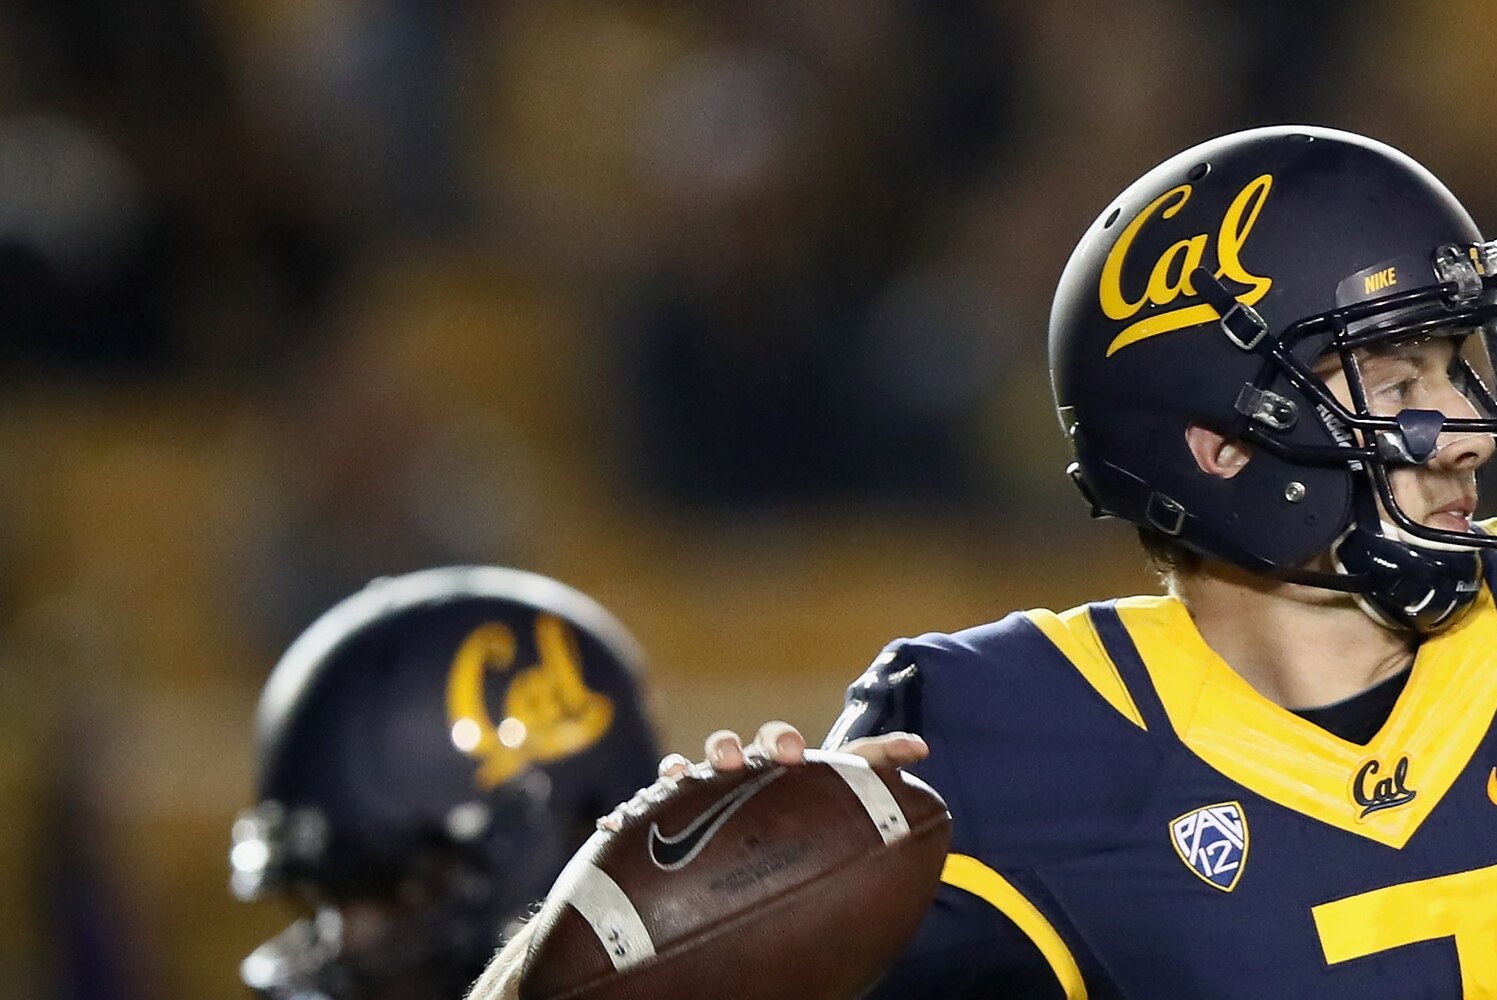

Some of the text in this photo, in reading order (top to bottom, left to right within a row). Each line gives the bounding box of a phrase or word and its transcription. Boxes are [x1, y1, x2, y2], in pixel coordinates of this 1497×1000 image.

[1099, 173, 1273, 358] Cal
[1364, 266, 1397, 295] NIKE
[446, 611, 614, 790] Cal
[1352, 756, 1417, 819] Cal
[1173, 805, 1245, 867] PAC
[1198, 838, 1240, 877] 12
